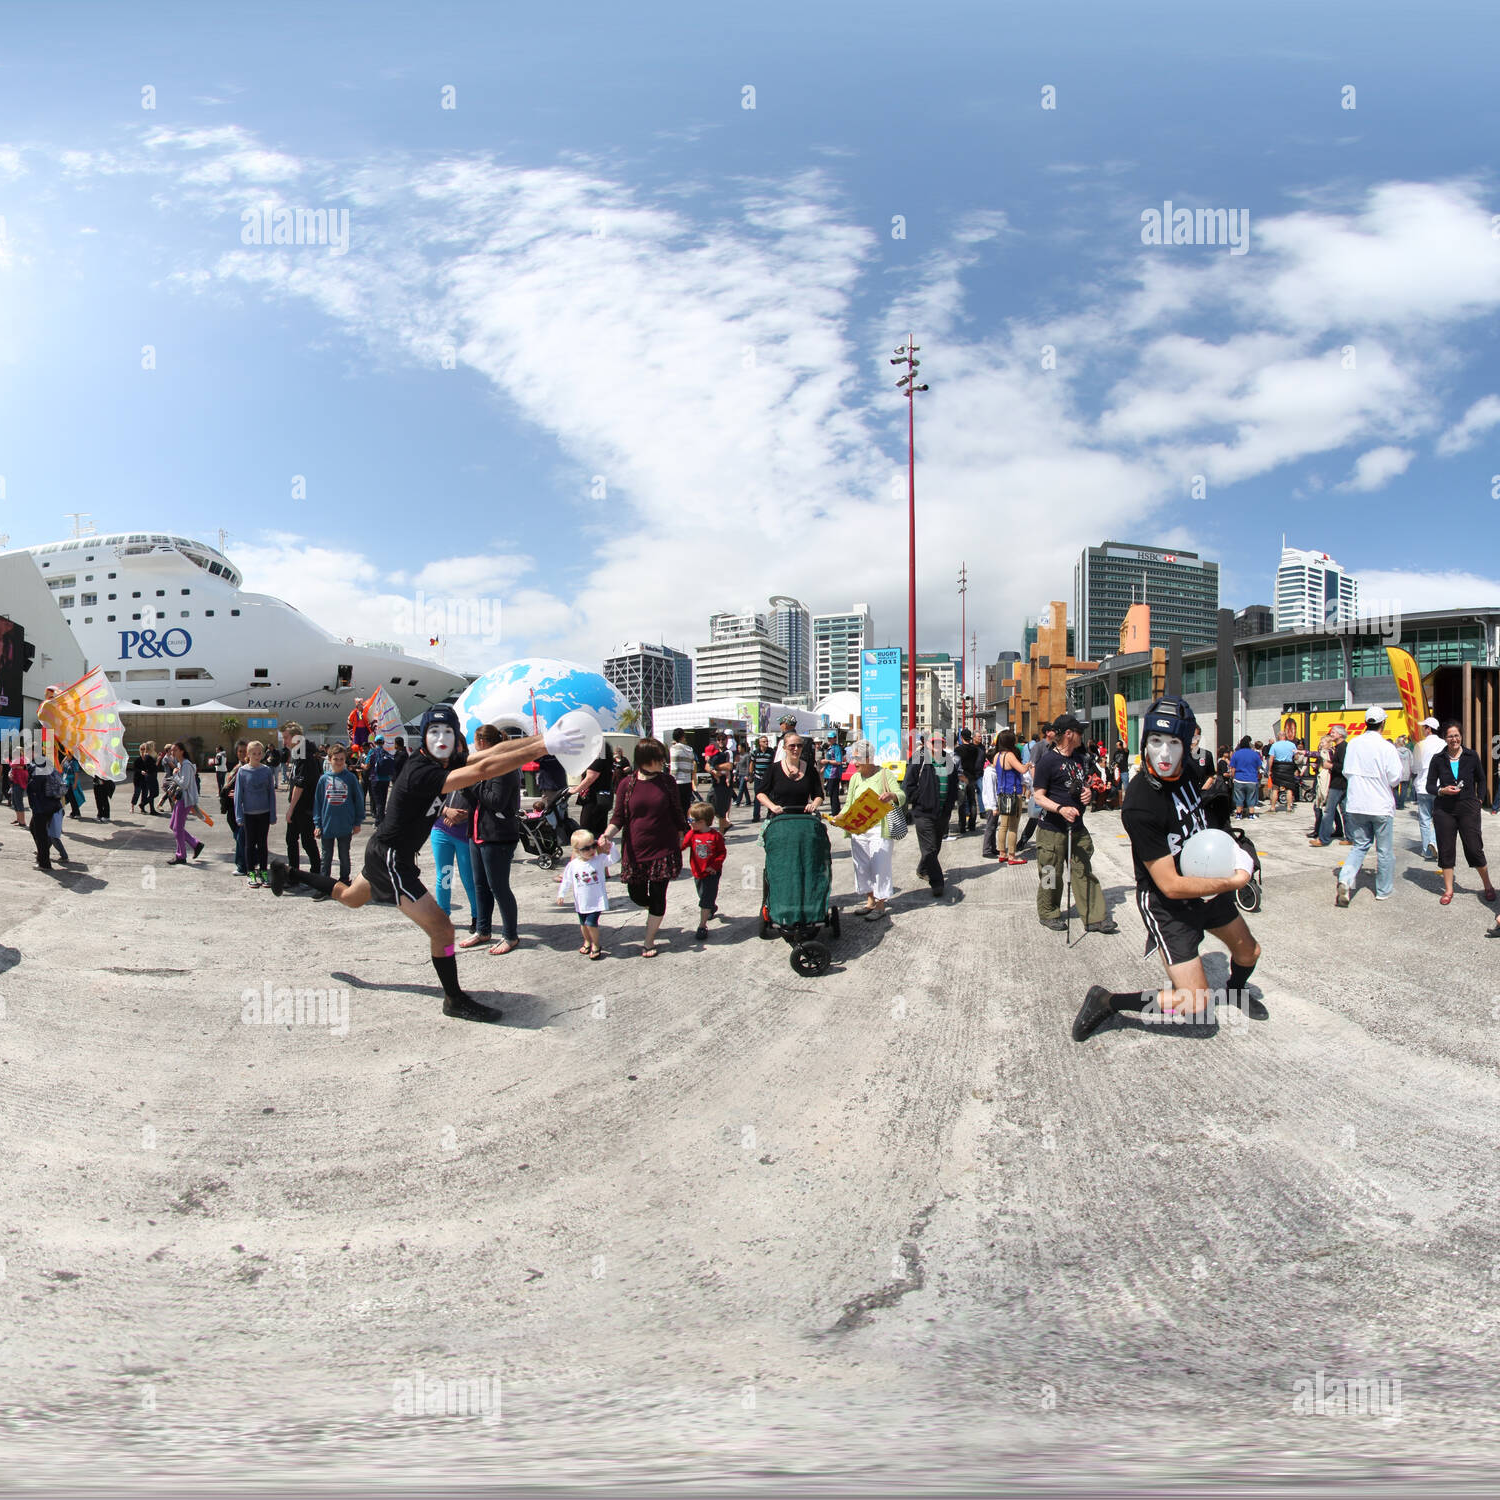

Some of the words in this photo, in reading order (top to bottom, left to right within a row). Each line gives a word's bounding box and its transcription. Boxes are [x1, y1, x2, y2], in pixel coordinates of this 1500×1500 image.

[1137, 551, 1162, 562] HSBC
[117, 627, 193, 660] P&O
[247, 699, 301, 709] PACIFIC
[305, 701, 342, 709] DAWN
[1171, 780, 1202, 821] ALL
